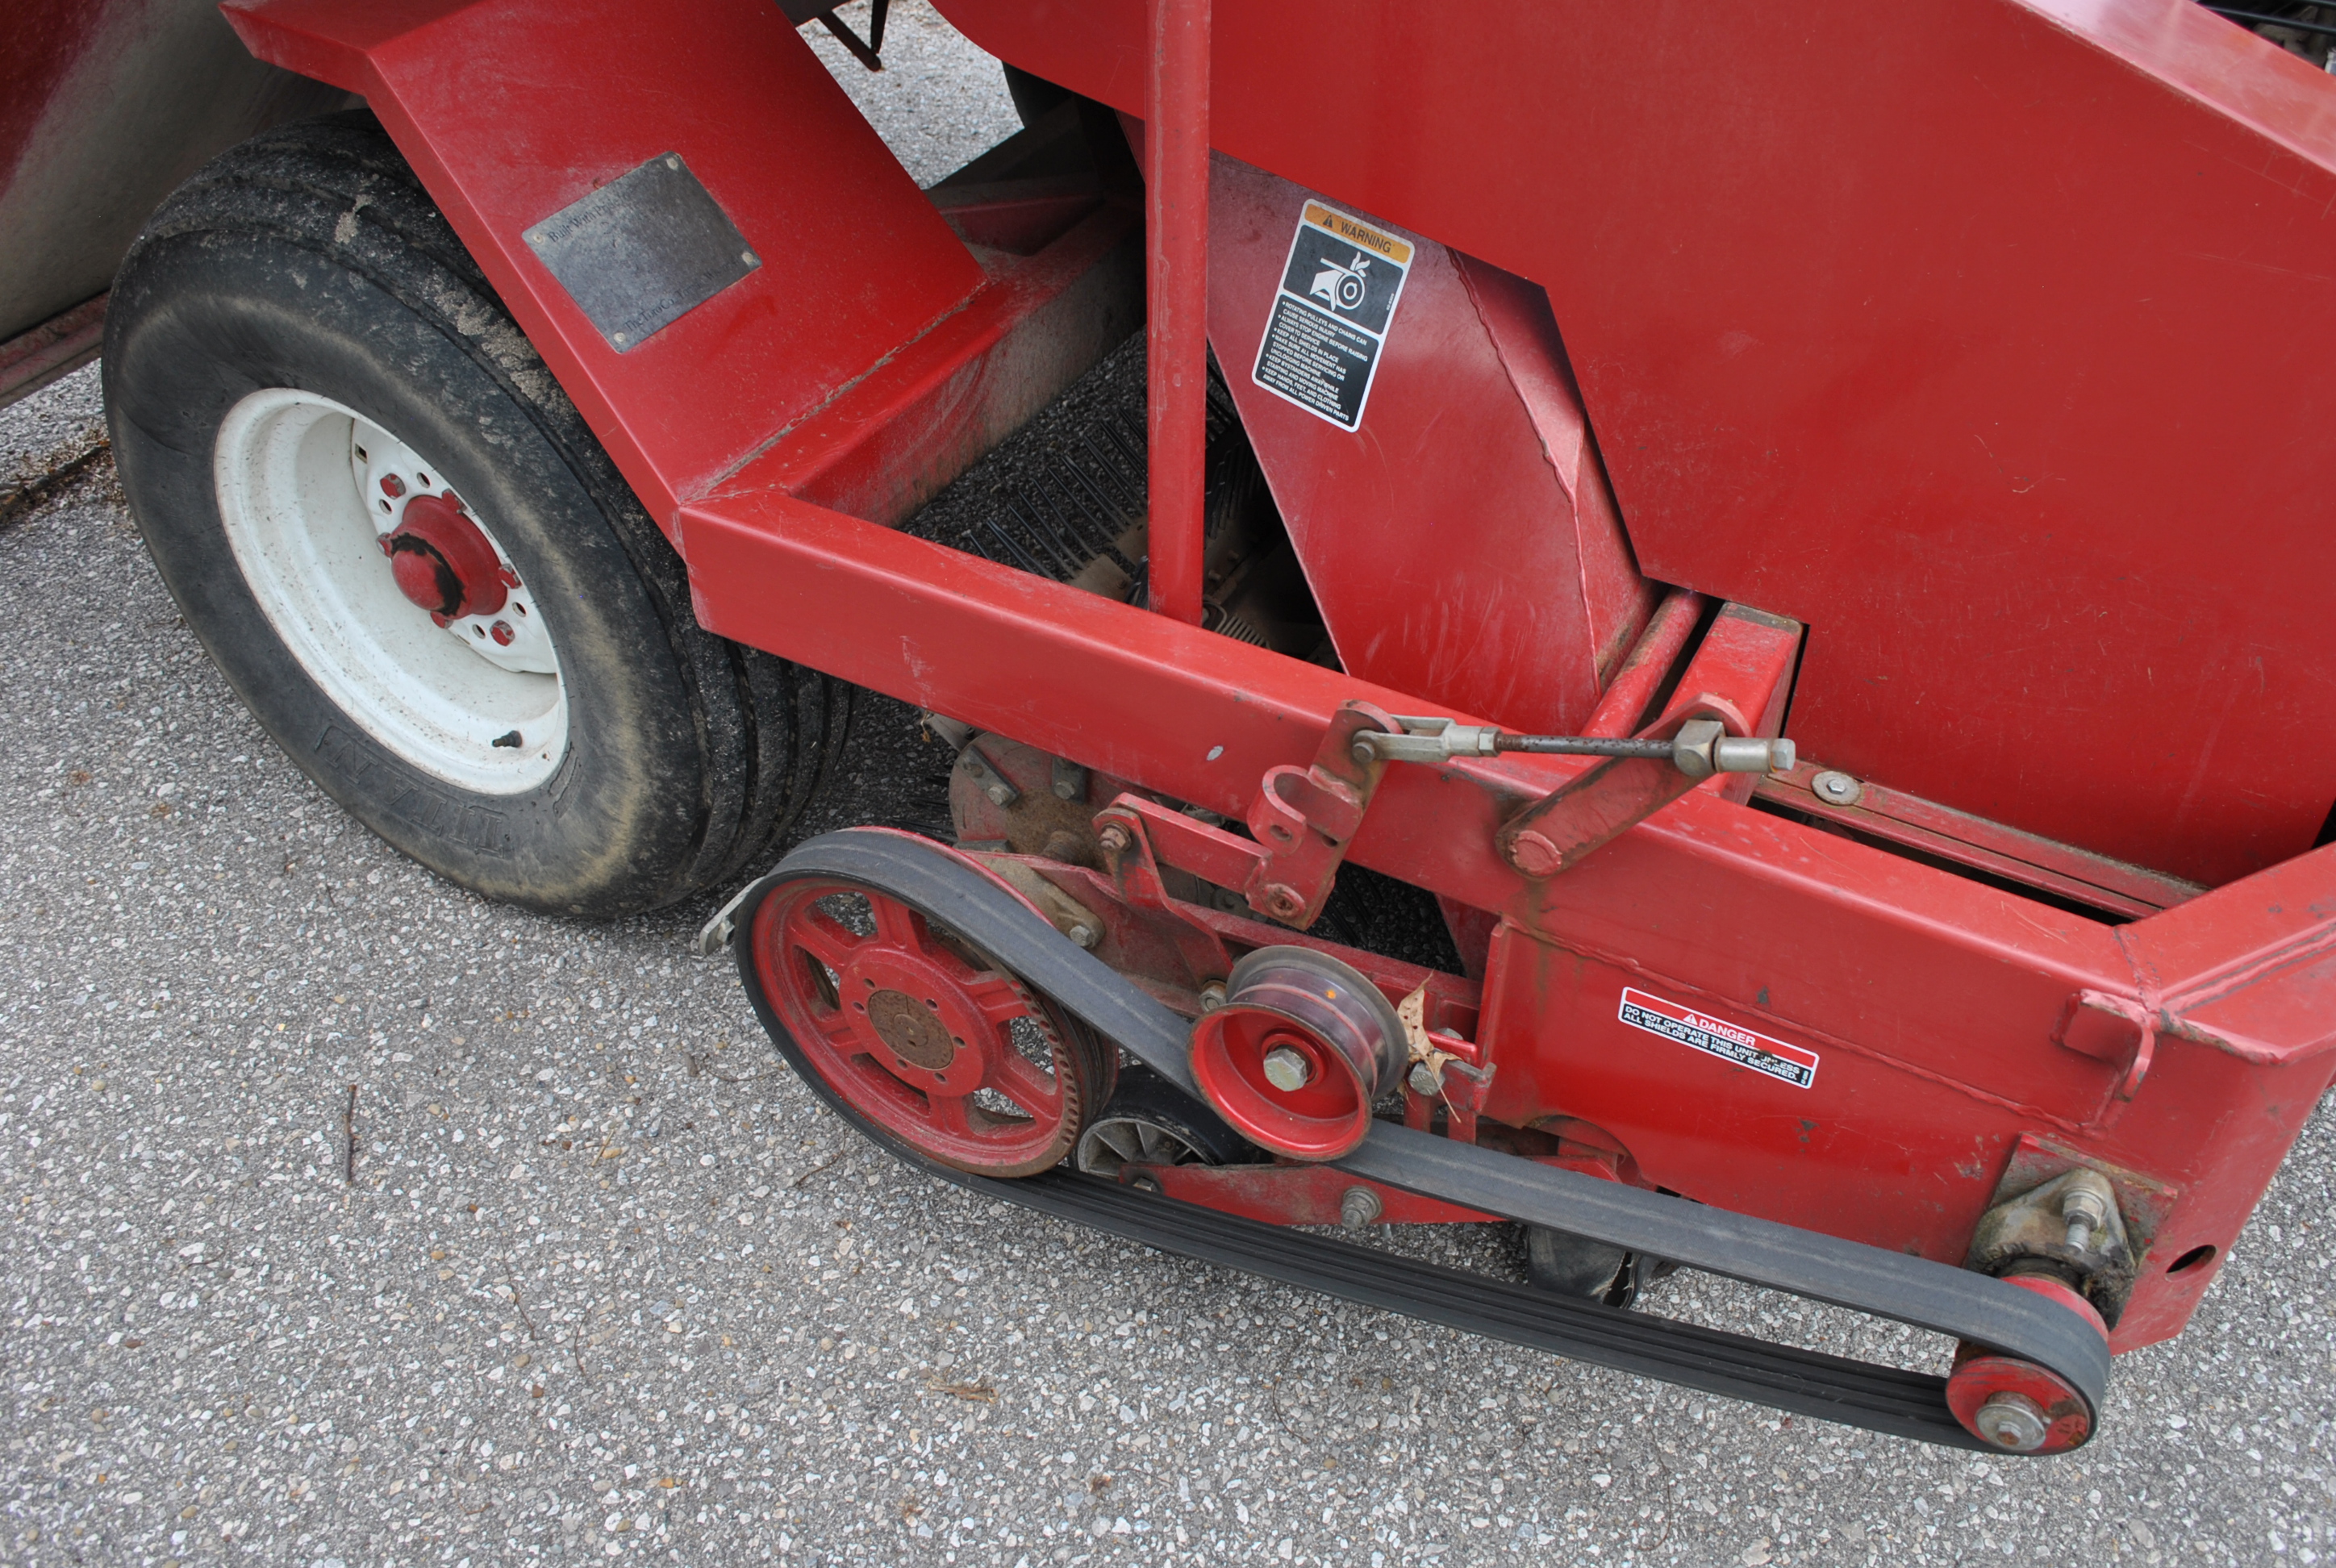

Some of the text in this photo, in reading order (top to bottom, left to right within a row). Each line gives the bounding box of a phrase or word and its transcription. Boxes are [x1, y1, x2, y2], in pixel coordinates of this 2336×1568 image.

[546, 223, 574, 243] Built
[570, 210, 596, 229] With
[1339, 221, 1392, 253] WARNING
[638, 303, 663, 323] Toro
[1283, 308, 1335, 338] CAUSE SERIOUS INJURY
[1285, 302, 1366, 345] ROTATING PULLEYS AND CHAINS CAN
[1276, 328, 1289, 338] KEEP
[1289, 334, 1298, 342] ALL
[1298, 339, 1317, 352] SHIELDS
[1323, 351, 1339, 363] PLACE
[1279, 321, 1294, 332] COVER
[1300, 332, 1320, 346] SERVICE
[1280, 315, 1367, 361] ALWAYS STOP ENGINE BEFORE RAISING
[1270, 347, 1320, 377] UNCLOGGING MACHINE
[1272, 341, 1293, 355] STOPPED
[1294, 352, 1312, 364] BEFORE
[1312, 361, 1336, 377] SERVICING
[1274, 335, 1346, 374] MAKE SURE ALL MOVEMENT HAS
[1264, 366, 1277, 377] KEEP
[1307, 388, 1316, 397] AND
[1317, 394, 1341, 410] CLOTHING
[1266, 360, 1338, 400] STARTING AND MOVING MACHINE
[1268, 354, 1339, 394] KEEP BYSTANDERS AWAY WHILE
[1262, 373, 1349, 421] AWAY FROM ALL POWER DRIVEN PARTS
[1623, 1011, 1642, 1024] ALL
[1644, 1019, 1686, 1040] SHIELDS
[1687, 1035, 1708, 1048] ARE
[1709, 1043, 1746, 1061] FIRMLY
[1746, 1056, 1798, 1080] SECURED.
[1625, 1005, 1640, 1016] DO
[1641, 1011, 1662, 1024] NOT
[1662, 1019, 1709, 1041] OPERATE
[1709, 1036, 1733, 1050] THIS
[1733, 1045, 1758, 1058] UNIT
[1698, 1018, 1756, 1046] DANGER
